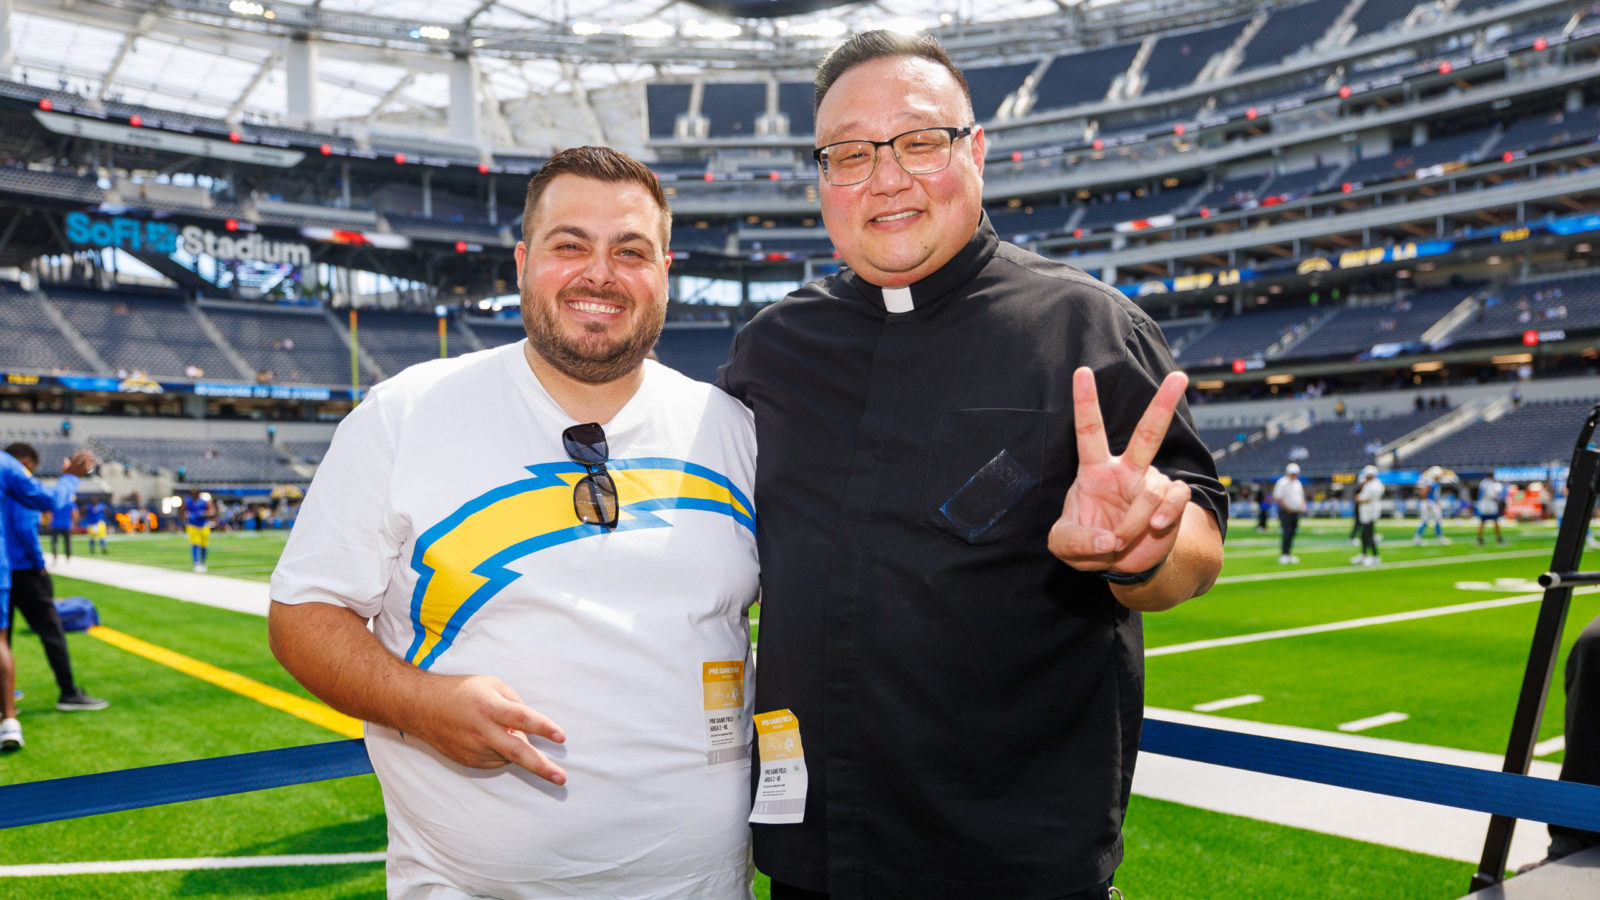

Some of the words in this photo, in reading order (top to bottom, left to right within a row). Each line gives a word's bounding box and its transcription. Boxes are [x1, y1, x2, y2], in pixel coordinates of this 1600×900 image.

[66, 211, 141, 250] SoFi
[182, 225, 312, 266] Stadium
[781, 715, 792, 723] FIELD
